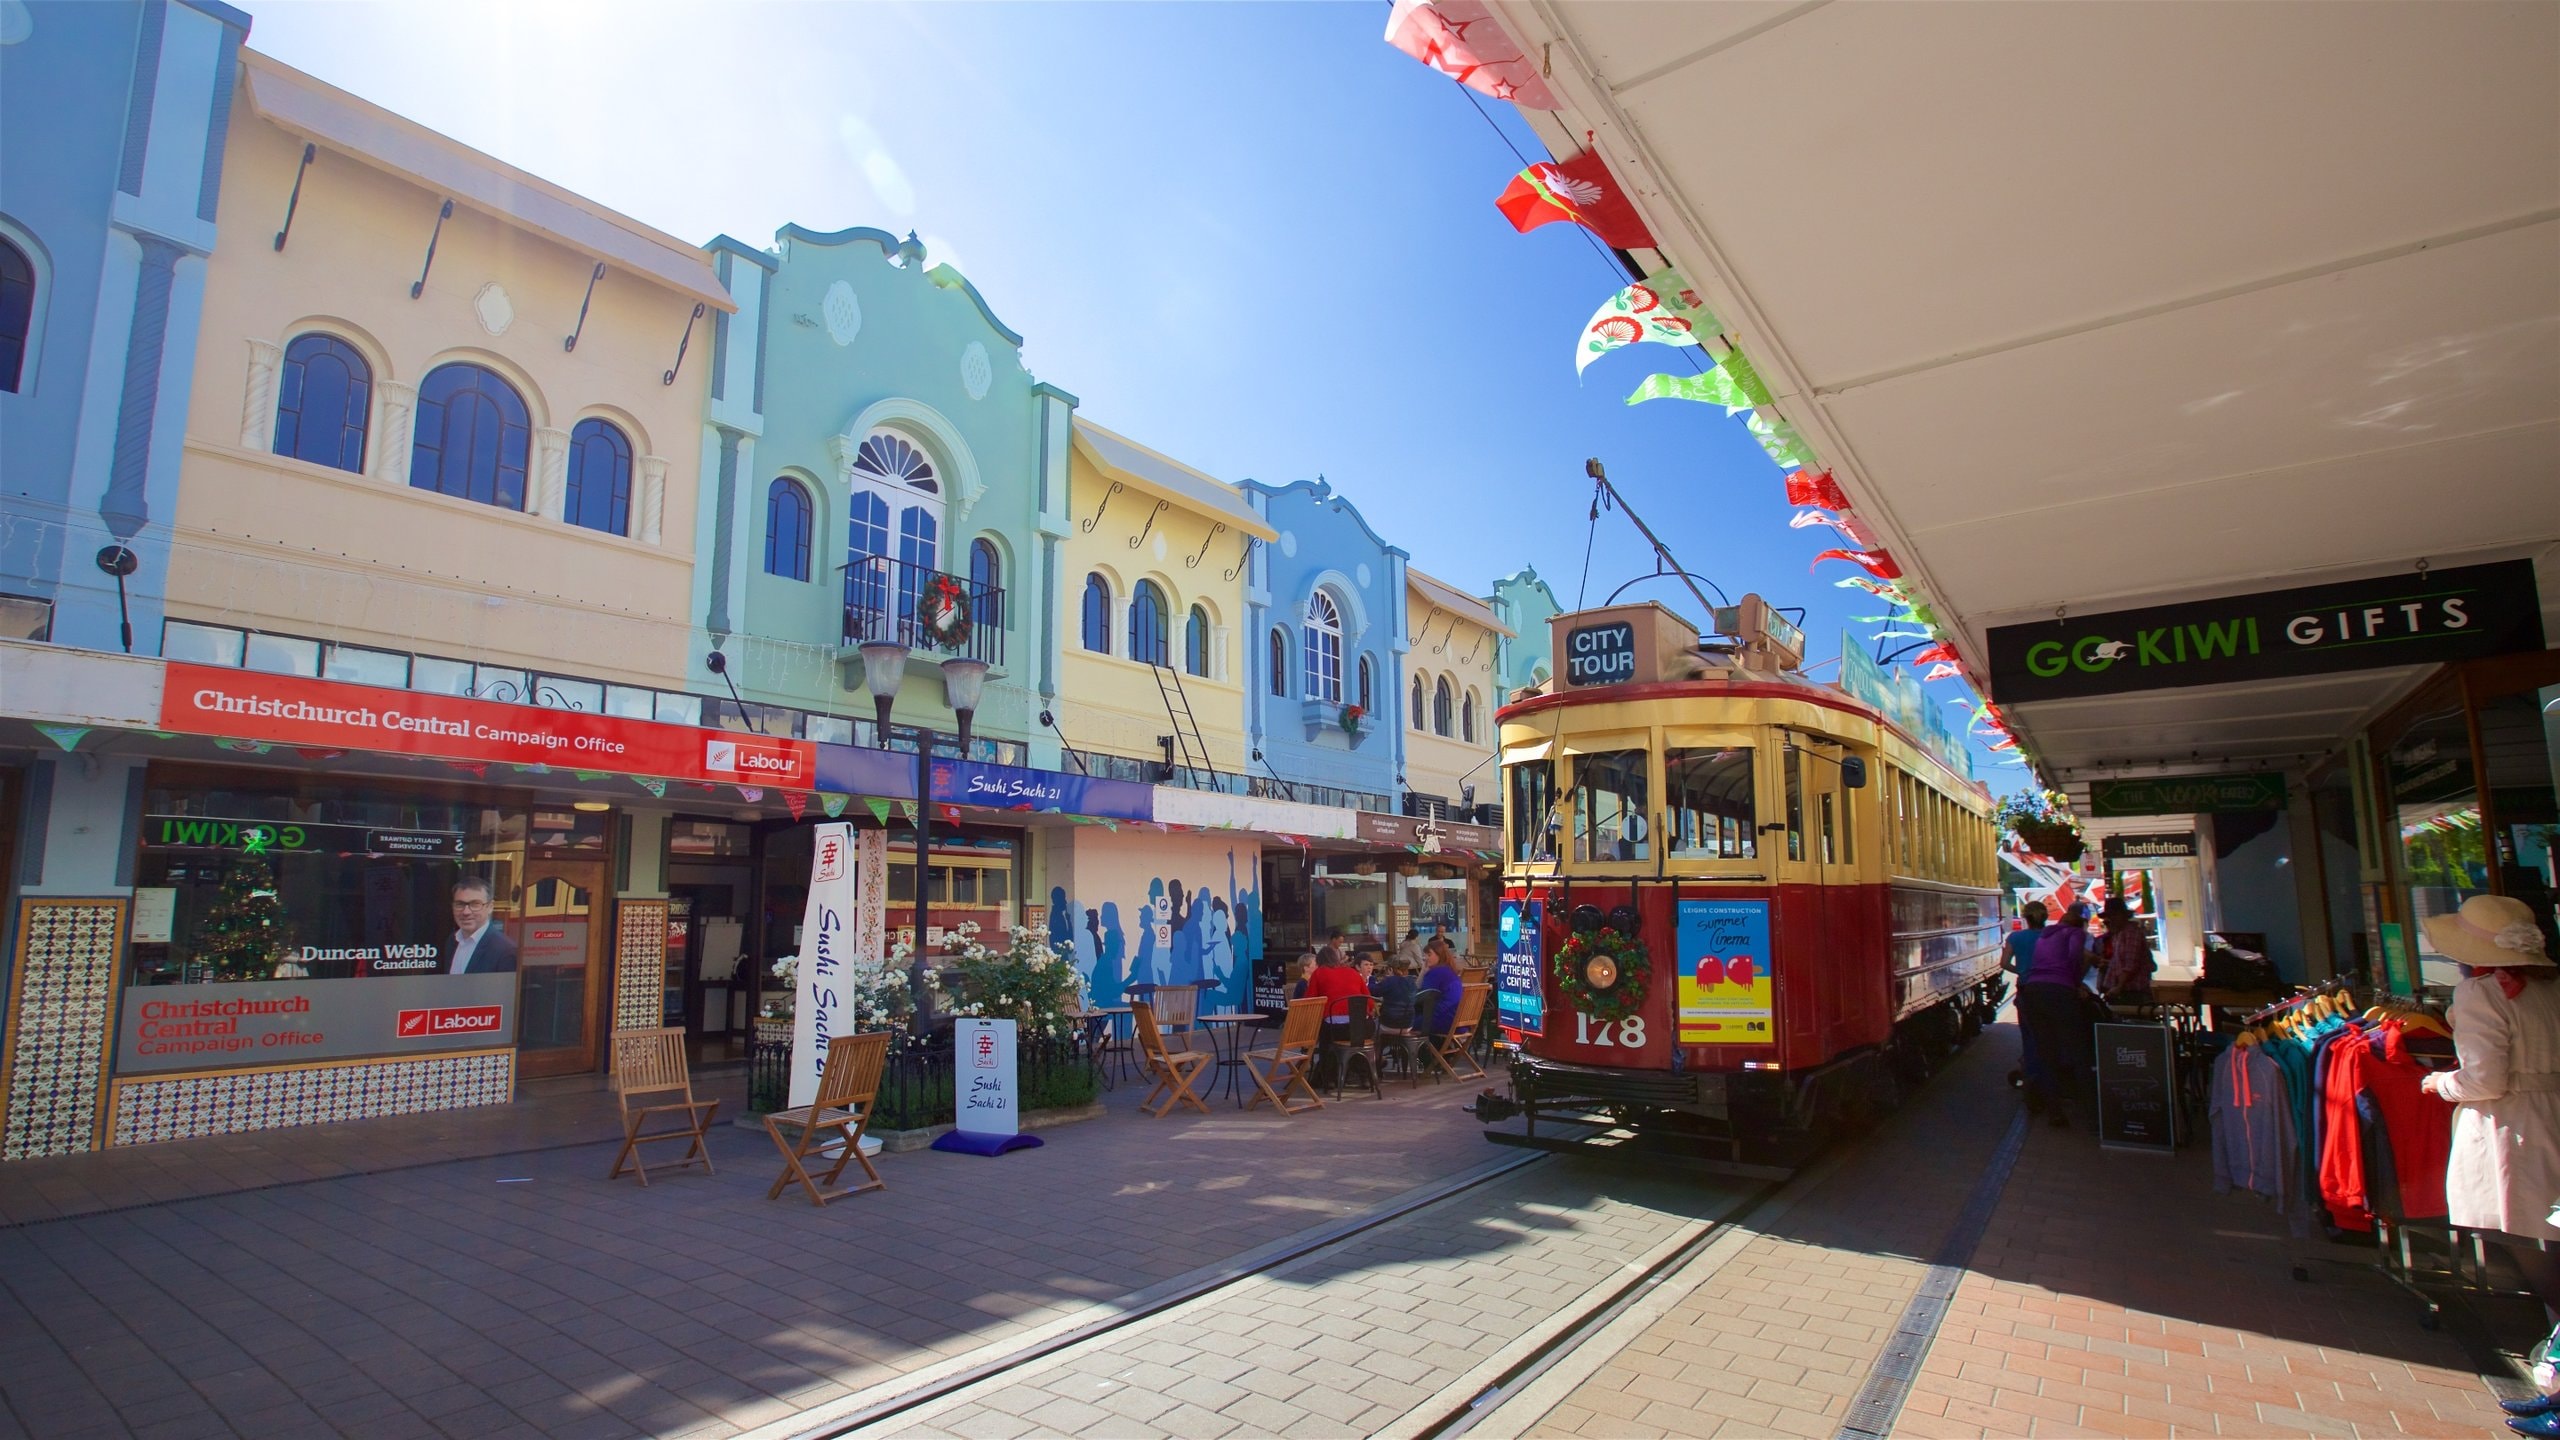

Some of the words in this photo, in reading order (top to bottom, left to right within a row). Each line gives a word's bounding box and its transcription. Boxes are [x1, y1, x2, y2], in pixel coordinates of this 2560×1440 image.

[1575, 628, 1627, 652] CITY
[2026, 635, 2115, 677] GO
[2137, 616, 2260, 667] KIWI
[2286, 598, 2469, 645] GIFTS
[1570, 651, 1634, 676] TOUR
[193, 689, 377, 728] Christchurch
[381, 711, 471, 737] Central
[474, 725, 568, 749] Campaign
[574, 736, 624, 753] Office
[739, 751, 795, 772] Labour
[968, 775, 1007, 794] Sushi
[1008, 780, 1046, 798] Sachi
[1048, 788, 1061, 800] 21
[2123, 842, 2189, 855] Institution
[816, 903, 841, 976] Sushi
[1710, 927, 1751, 954] Cinema
[301, 945, 380, 962] Duncan
[383, 943, 437, 960] Webb
[1502, 953, 1517, 963] NOW
[373, 959, 437, 970] Candidate
[1500, 964, 1508, 974] AT
[1509, 965, 1521, 975] THE
[140, 995, 310, 1020] Christchurch
[1255, 998, 1286, 1009] COFFEE
[433, 1013, 496, 1030] Labour
[813, 982, 838, 1051] Sachi
[137, 1019, 237, 1041] Central
[1576, 1011, 1647, 1048] 178
[136, 1036, 254, 1056] Campaign
[261, 1030, 324, 1048] Office
[971, 1076, 1002, 1092] Sushi
[966, 1095, 994, 1109] Sachi
[996, 1097, 1007, 1109] 21
